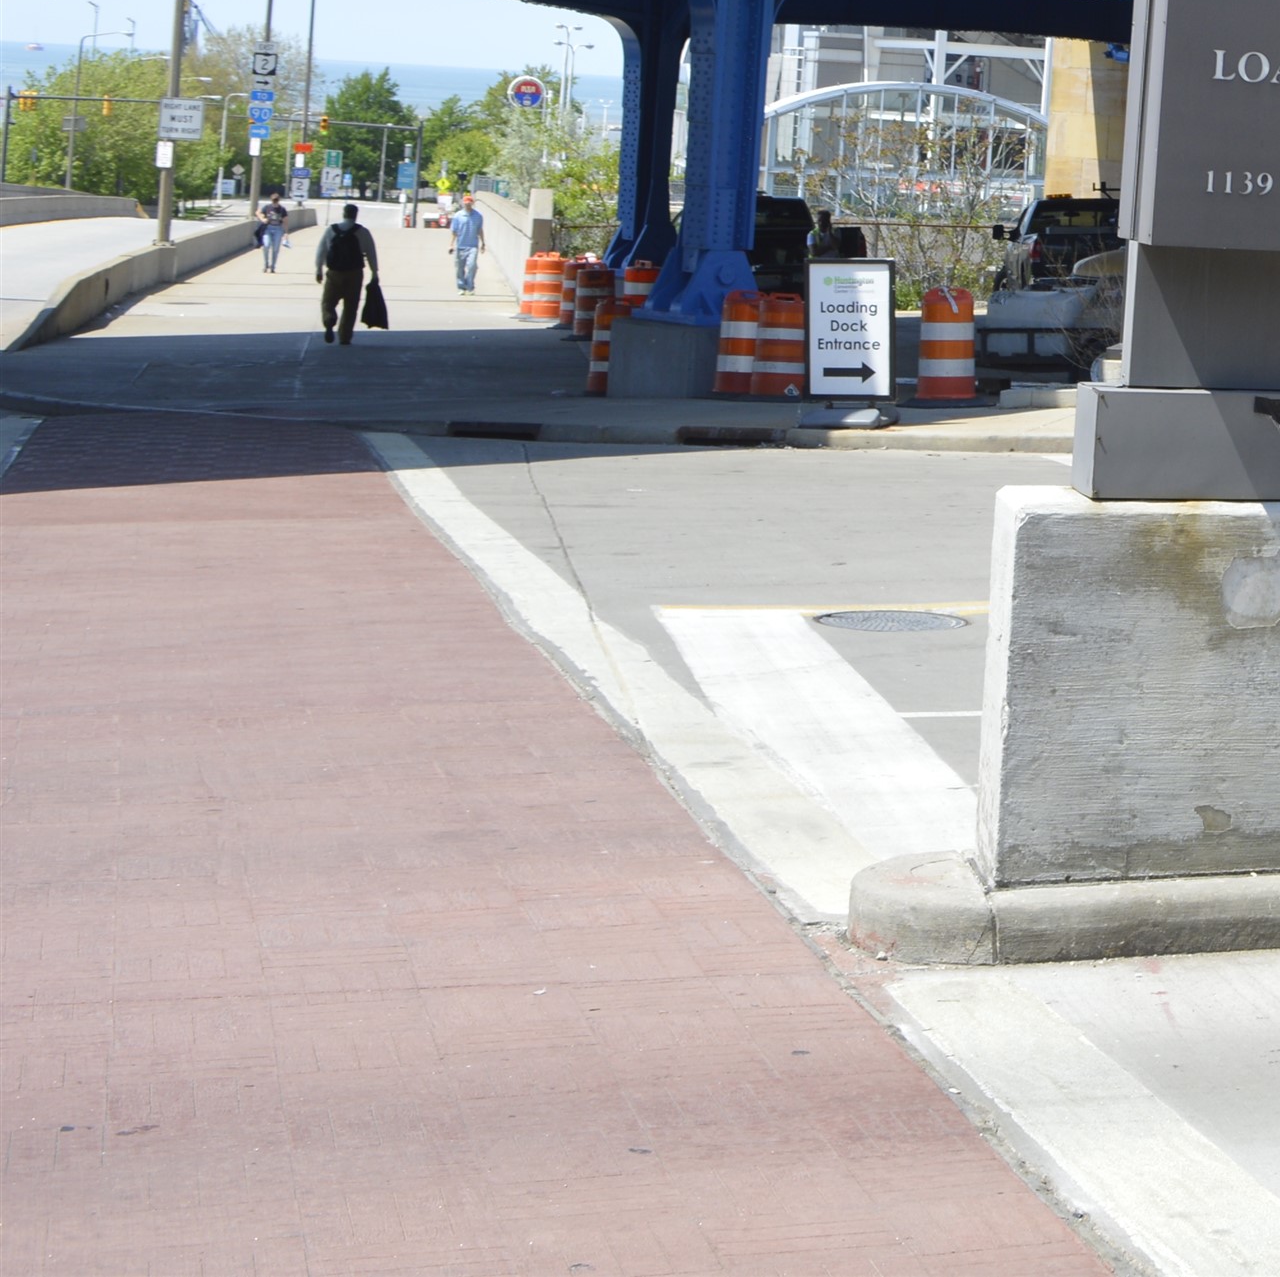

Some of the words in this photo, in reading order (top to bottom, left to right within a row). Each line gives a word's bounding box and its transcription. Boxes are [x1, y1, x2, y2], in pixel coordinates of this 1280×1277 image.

[260, 58, 270, 71] 2
[257, 92, 268, 100] TO
[170, 115, 193, 123] MUST
[251, 108, 270, 119] 90
[296, 181, 303, 190] 2
[1205, 169, 1274, 196] 1139
[820, 301, 878, 316] Loading
[831, 319, 868, 332] Dock
[818, 338, 880, 350] Entrance
